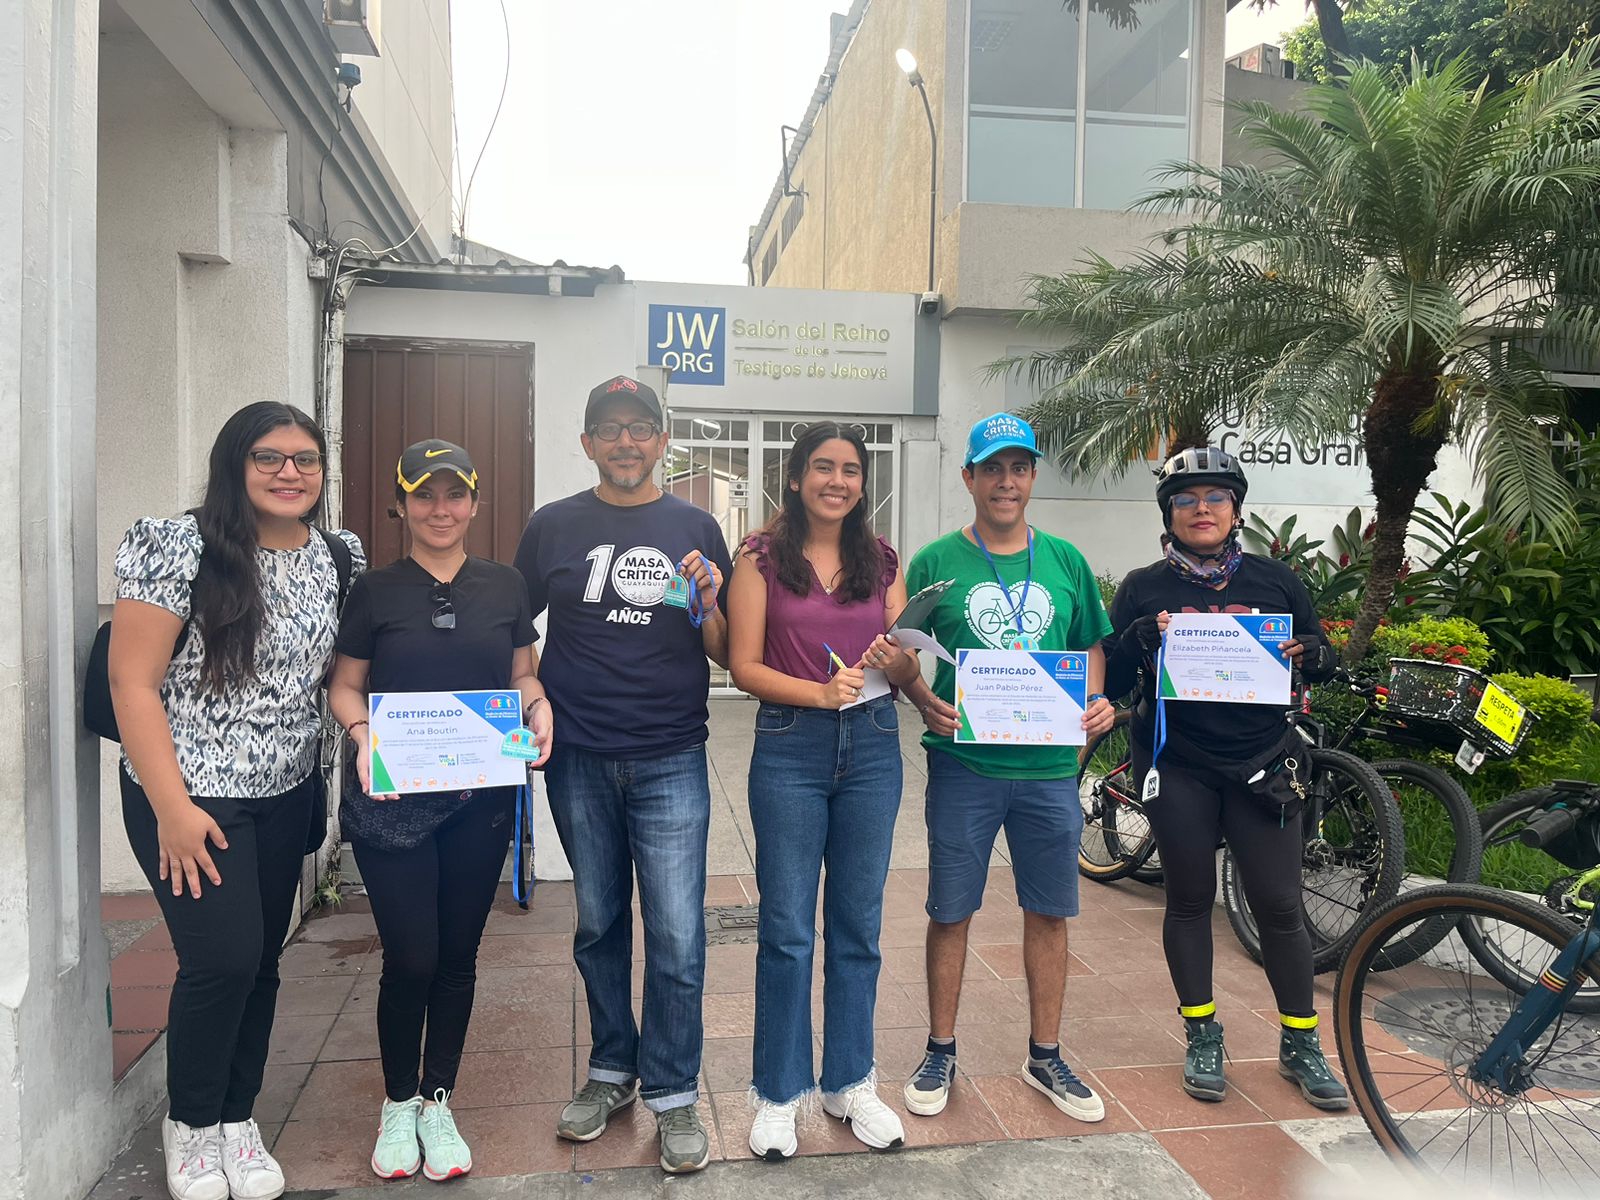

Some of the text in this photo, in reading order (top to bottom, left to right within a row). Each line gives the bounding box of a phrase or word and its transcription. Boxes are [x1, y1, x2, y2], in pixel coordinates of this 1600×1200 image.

[656, 311, 719, 350] JW
[732, 319, 890, 343] Salón del Reino
[793, 345, 828, 356] de los
[662, 351, 713, 373] ORG
[734, 359, 887, 381] Testigos de Jehová
[987, 417, 1019, 428] MASA
[1220, 431, 1291, 465] Casa
[625, 557, 665, 568] MASA
[617, 567, 670, 580] CRÍTICA
[606, 607, 653, 625] AÑOS
[1174, 629, 1239, 637] CERTIFICADO
[1172, 644, 1210, 652] Elizabeth
[971, 667, 1036, 675] CERTIFICADO
[387, 709, 463, 719] CERTIFICADO
[1488, 695, 1515, 720] RESPETA
